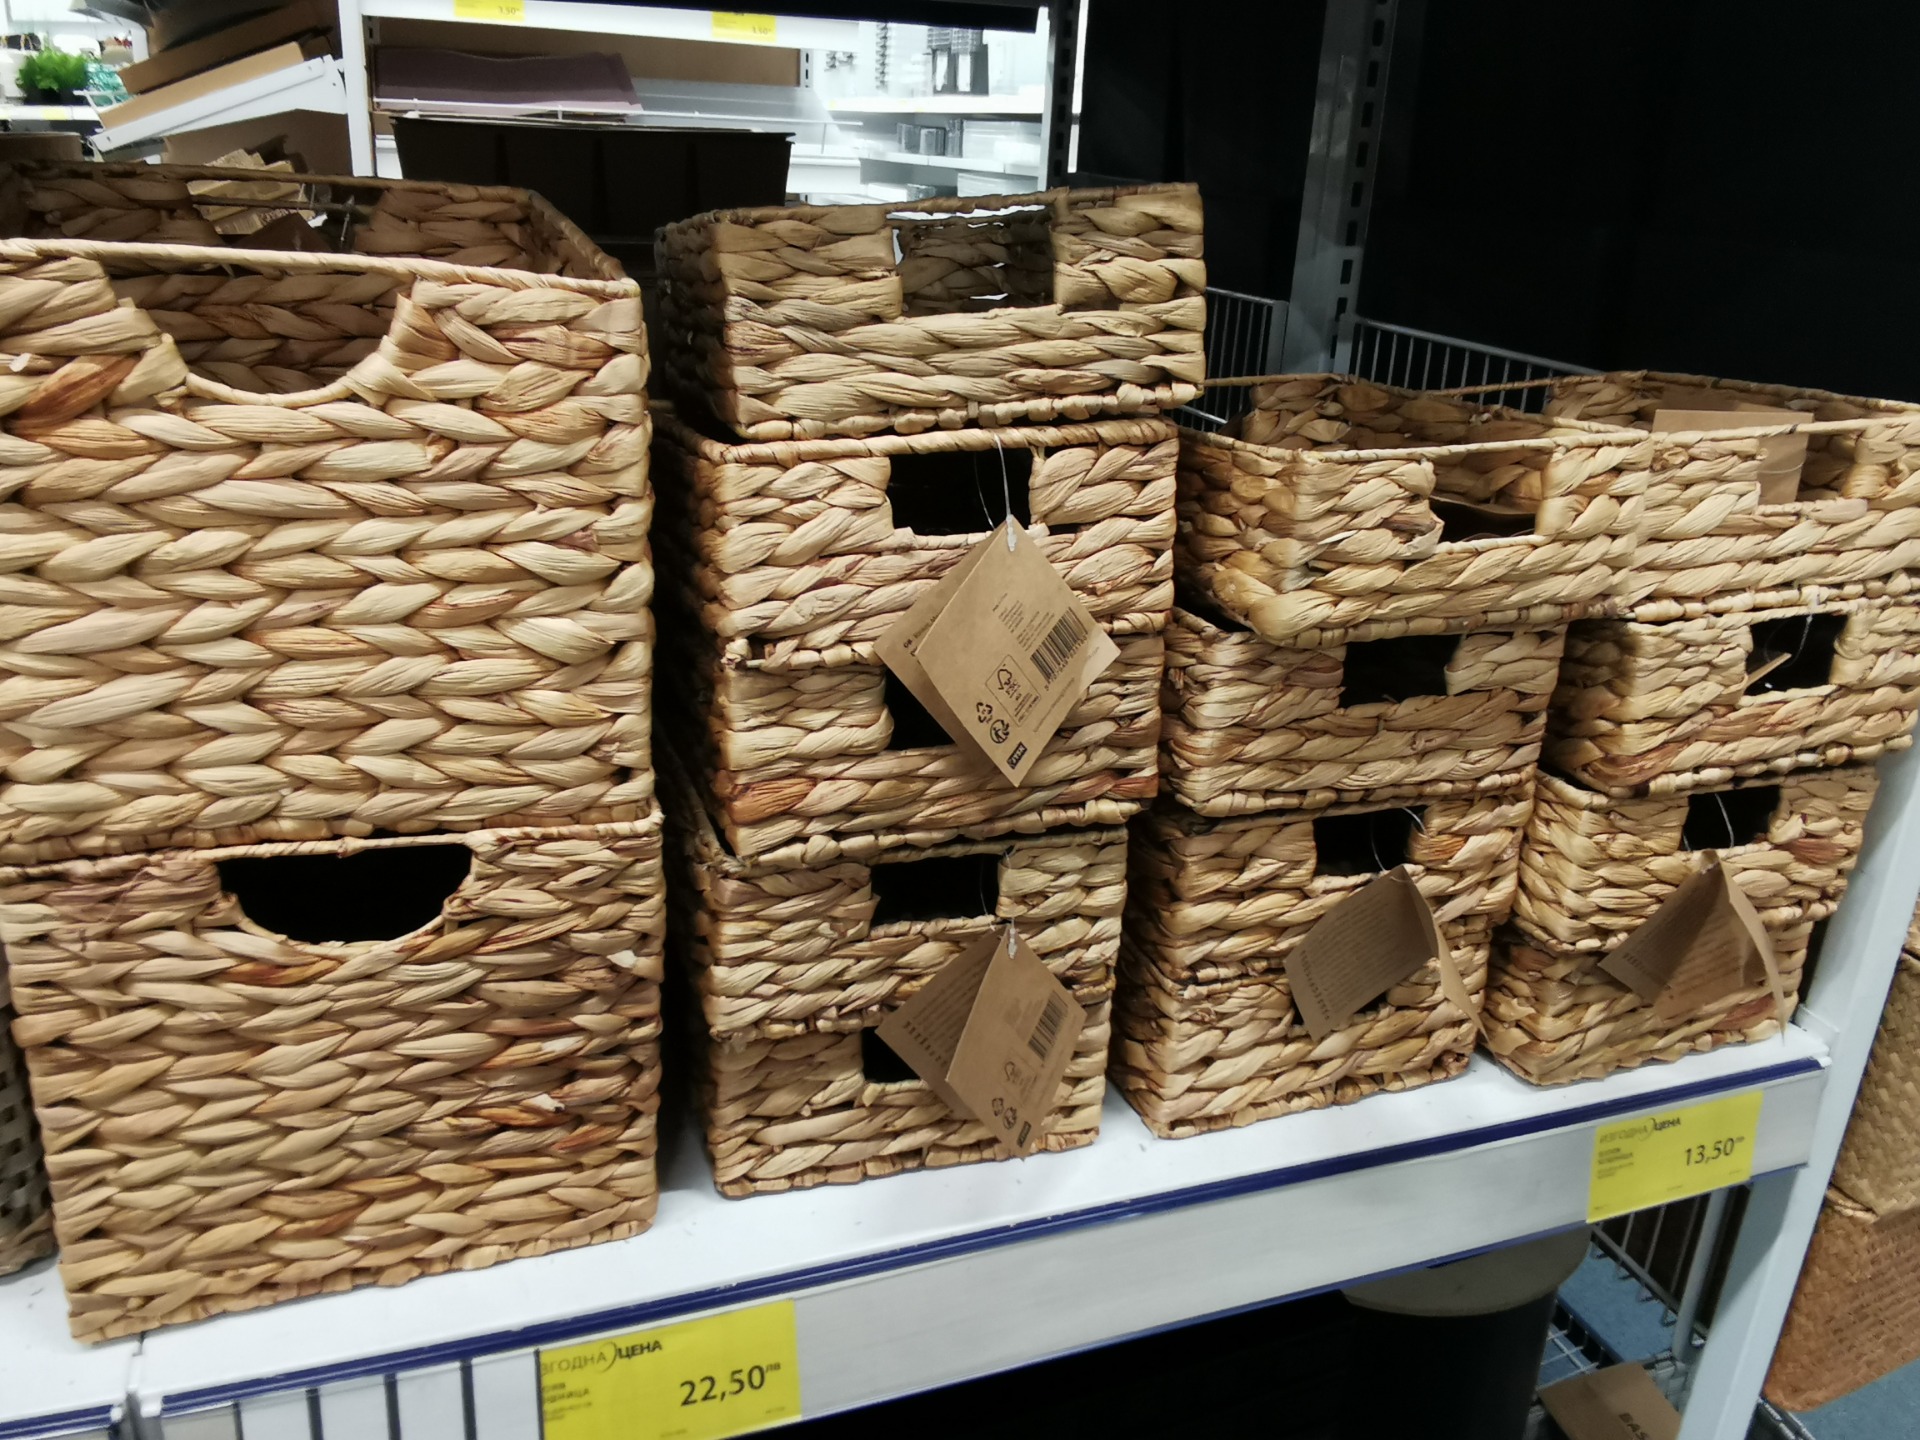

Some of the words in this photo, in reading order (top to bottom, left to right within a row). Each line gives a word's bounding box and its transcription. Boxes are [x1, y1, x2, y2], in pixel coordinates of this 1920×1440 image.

[1685, 1138, 1735, 1166] 13,50
[541, 1351, 607, 1376] ЗГОДНА
[615, 1340, 662, 1360] ЦЕНА
[680, 1365, 765, 1407] 22,50
